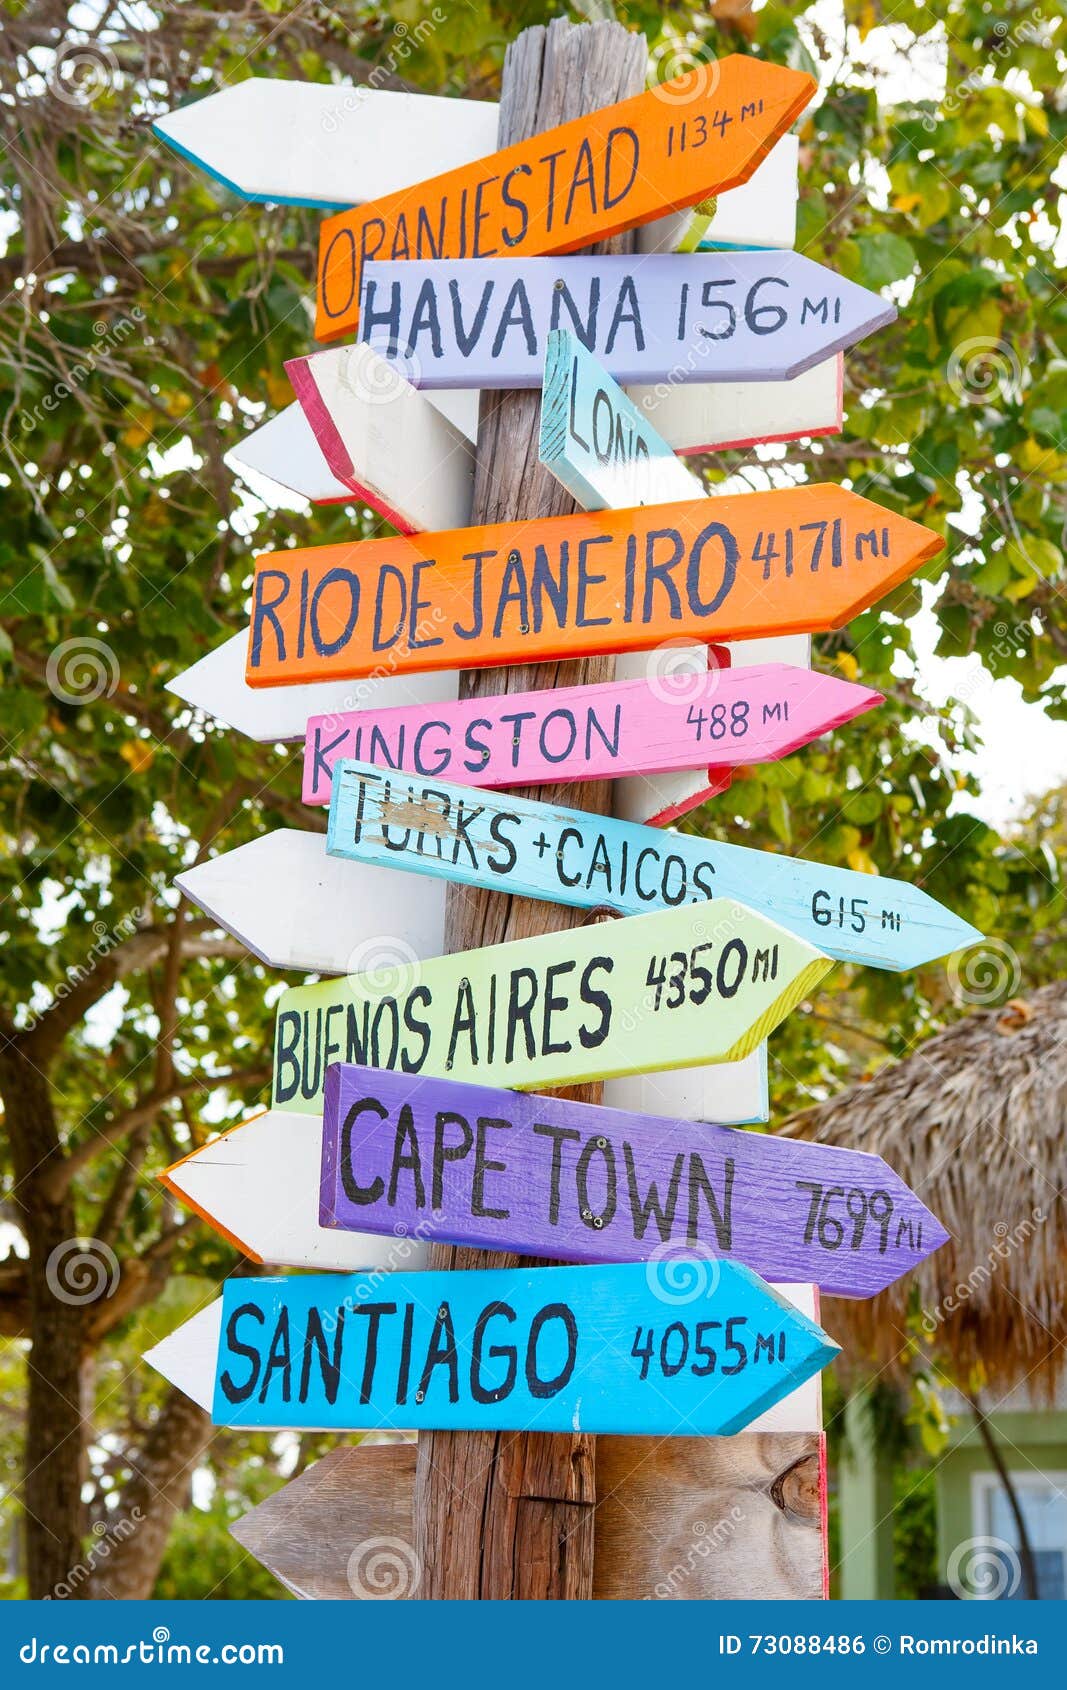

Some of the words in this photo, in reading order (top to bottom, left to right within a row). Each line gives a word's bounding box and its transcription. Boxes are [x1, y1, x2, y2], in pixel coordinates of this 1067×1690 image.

[322, 127, 640, 318] ORANJESTAD
[668, 109, 733, 157] 1134
[741, 99, 763, 122] MI
[363, 276, 645, 358] HAVANA
[677, 276, 788, 341] 156
[800, 296, 841, 326] MI
[250, 568, 360, 667] RIO
[372, 560, 444, 652] DE
[454, 521, 739, 640] JANEIRO
[751, 518, 843, 579] 4171
[855, 527, 890, 561] MI
[312, 704, 621, 793] KINGSTON
[686, 700, 750, 741] 488
[763, 702, 789, 724] MI
[344, 770, 521, 874] TURKS
[811, 890, 868, 933] 615
[881, 909, 901, 932] MI
[275, 985, 432, 1103] BUENOS
[445, 956, 614, 1071] AIRES
[646, 938, 748, 1011] 4350
[752, 944, 779, 983] MI
[339, 1097, 513, 1220] CAPE
[533, 1124, 735, 1251] TOWN
[796, 1181, 894, 1255] 7699
[896, 1217, 923, 1251] MI
[220, 1301, 579, 1405] SANTIAGO
[631, 1316, 747, 1380] 4055
[753, 1332, 785, 1364] MI
